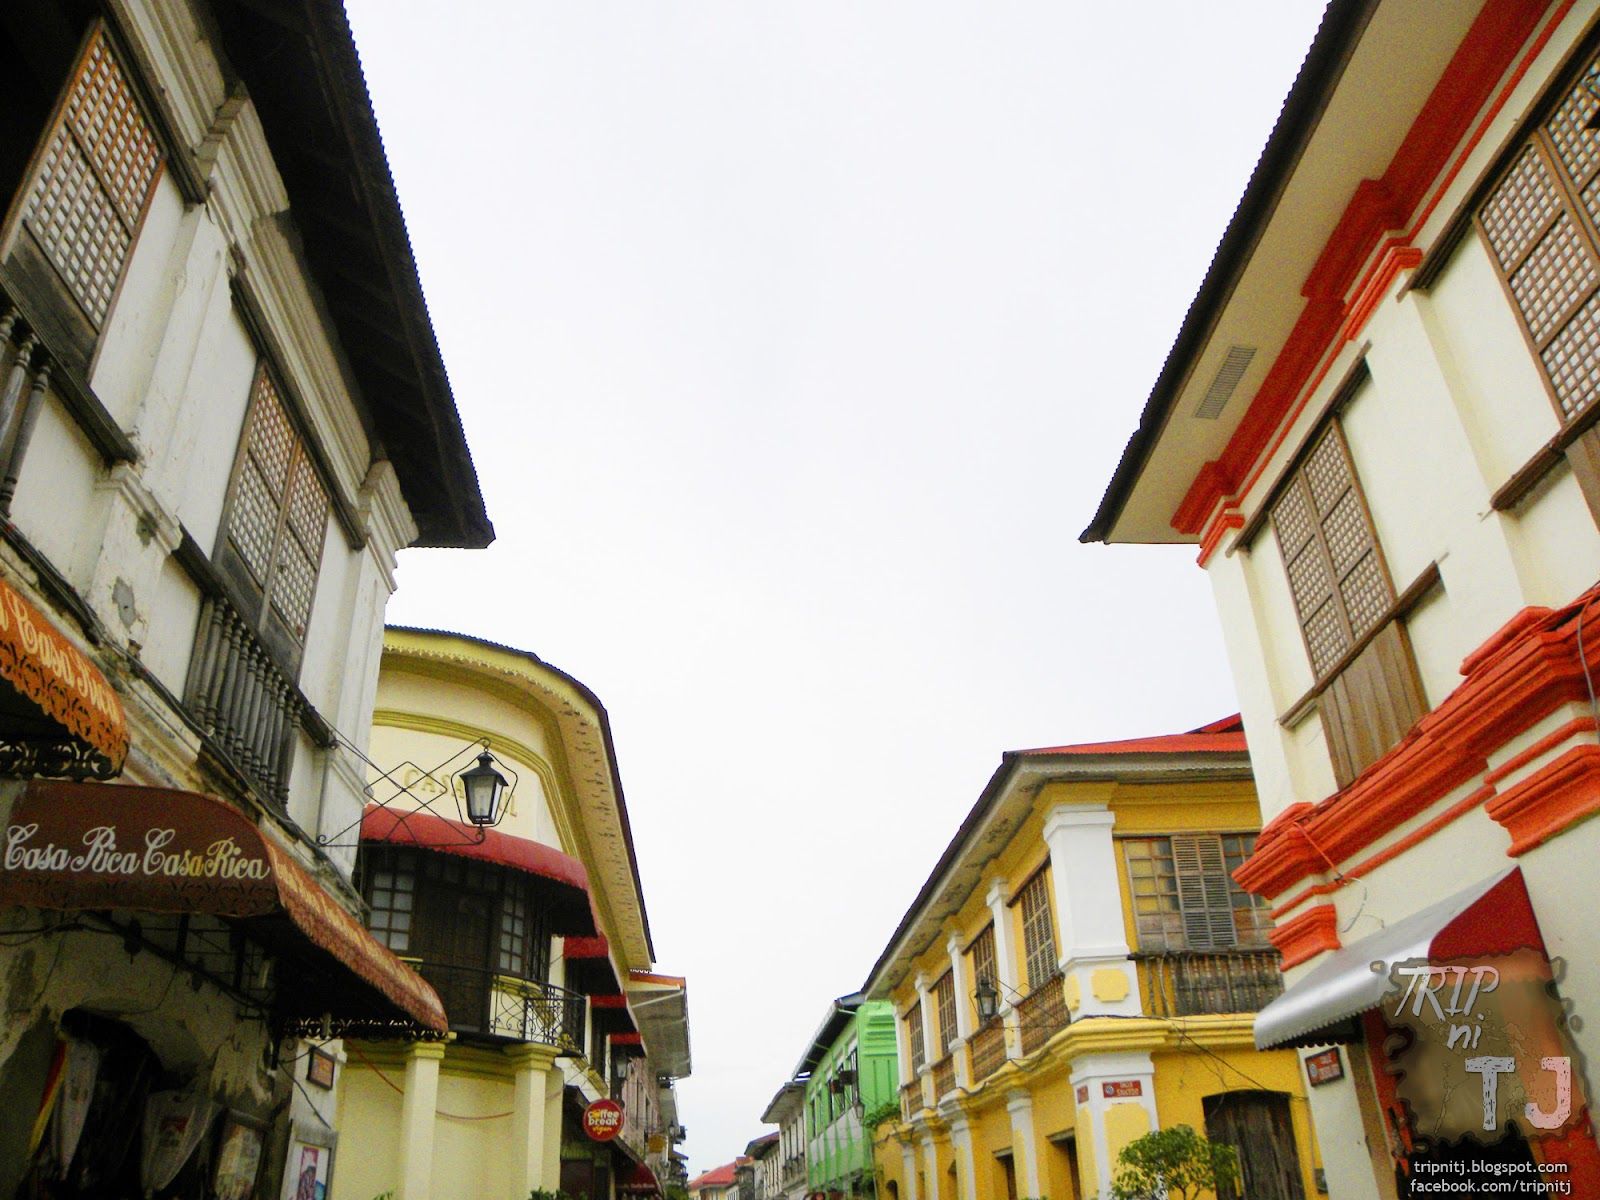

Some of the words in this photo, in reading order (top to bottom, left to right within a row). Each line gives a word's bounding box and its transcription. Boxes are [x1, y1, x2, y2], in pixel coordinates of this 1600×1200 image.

[4, 823, 72, 871] Casa
[70, 826, 140, 874] Rica
[143, 828, 205, 876] Casa
[203, 836, 271, 880] Rica
[588, 1109, 620, 1119] coffee
[588, 1118, 618, 1127] break
